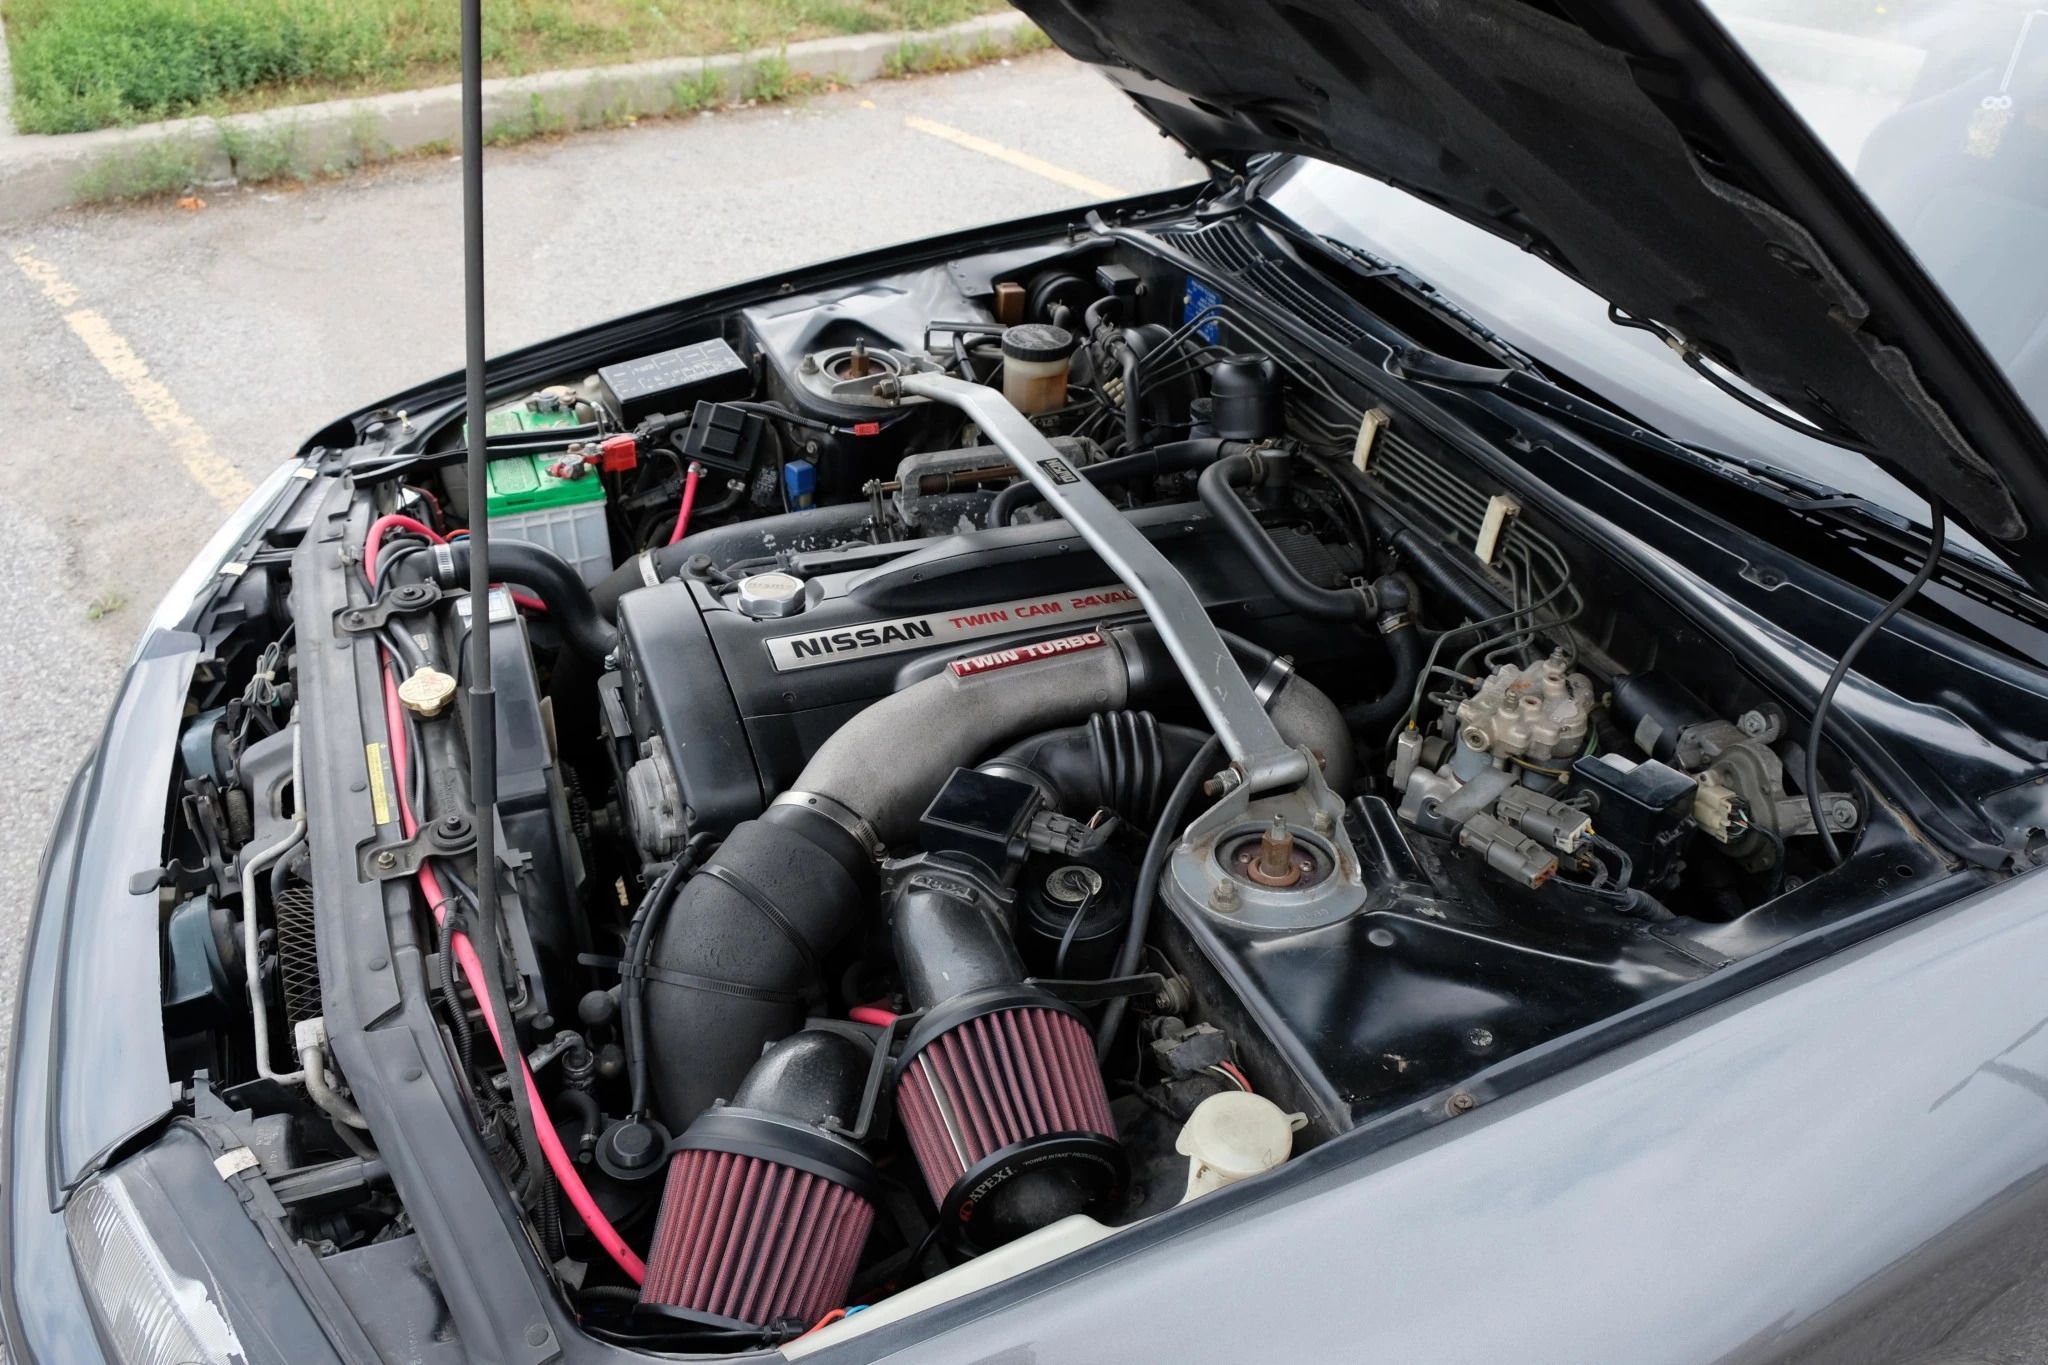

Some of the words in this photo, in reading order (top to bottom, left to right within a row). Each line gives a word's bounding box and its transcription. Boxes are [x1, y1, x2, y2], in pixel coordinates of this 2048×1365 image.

[791, 620, 933, 658] NISSAN
[950, 611, 1009, 629] TWIN
[1015, 602, 1062, 618] CAM
[1070, 590, 1137, 609] 24VAL
[957, 649, 1019, 671] TWIN
[1023, 633, 1101, 657] TURBO
